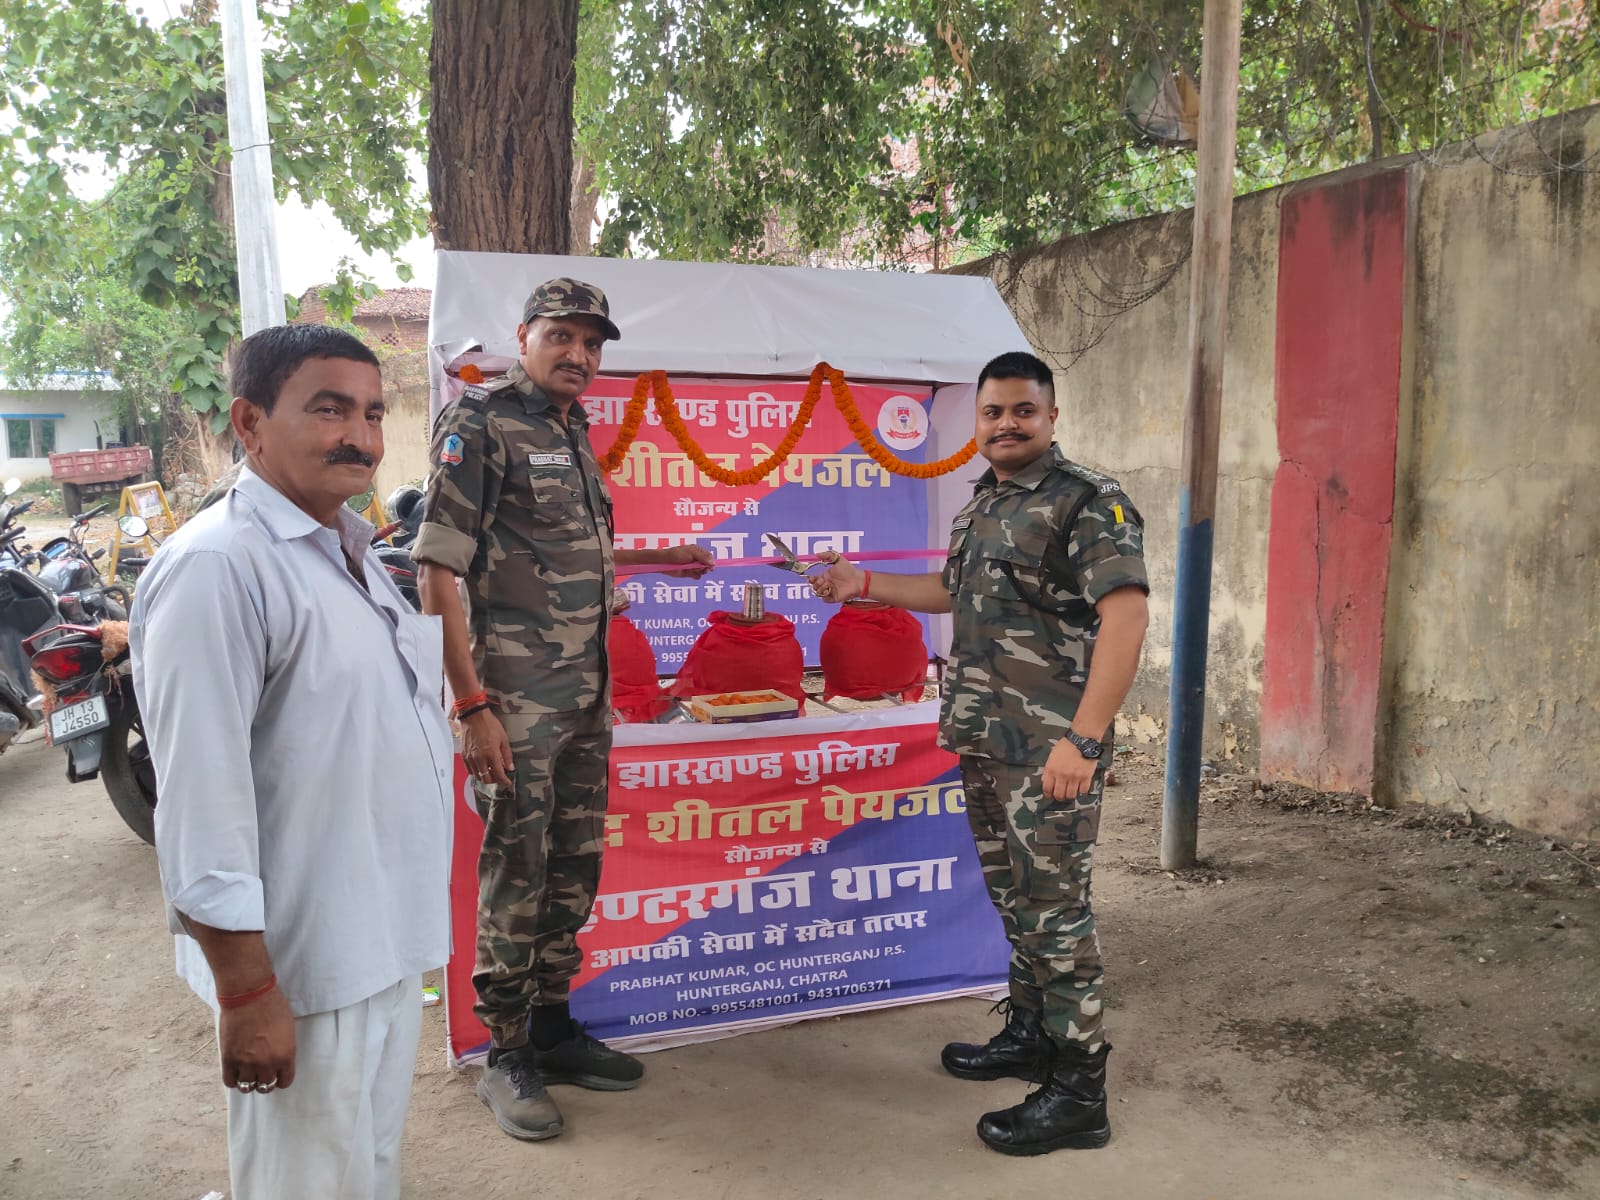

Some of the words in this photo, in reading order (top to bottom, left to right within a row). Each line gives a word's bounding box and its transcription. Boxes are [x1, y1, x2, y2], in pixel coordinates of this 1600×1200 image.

[1101, 482, 1119, 493] JPS
[673, 498, 739, 516] सौजन्य
[743, 497, 760, 516] से
[653, 582, 699, 602] सेवा
[704, 580, 725, 602] में
[644, 618, 694, 630] KUMAR,
[802, 613, 821, 624] P.S.
[61, 707, 75, 722] JH
[81, 700, 94, 714] 13
[62, 711, 99, 734] J4550
[617, 752, 784, 790] झारखण्ड
[792, 740, 901, 785] पुलिस
[646, 799, 809, 843] शीतल
[724, 843, 804, 864] सौजन्य
[809, 837, 830, 855] से
[831, 856, 958, 902] थाना
[590, 935, 692, 969] आपकी
[699, 931, 756, 955] सेवा
[763, 922, 788, 946] में
[794, 918, 857, 943] सदैव
[862, 909, 928, 934] तत्पर
[610, 972, 684, 993] PRABHAT
[689, 964, 750, 982] KUMAR,
[754, 960, 777, 974] OC
[780, 947, 880, 971] HUNTERGANJ
[884, 944, 906, 957] P.S.
[676, 977, 786, 1002] HUNTERGANJ,
[789, 969, 849, 988] CHATRA
[630, 1011, 668, 1026] MOB
[711, 993, 804, 1015] 9955481001,
[808, 978, 892, 1001] 9431706371
